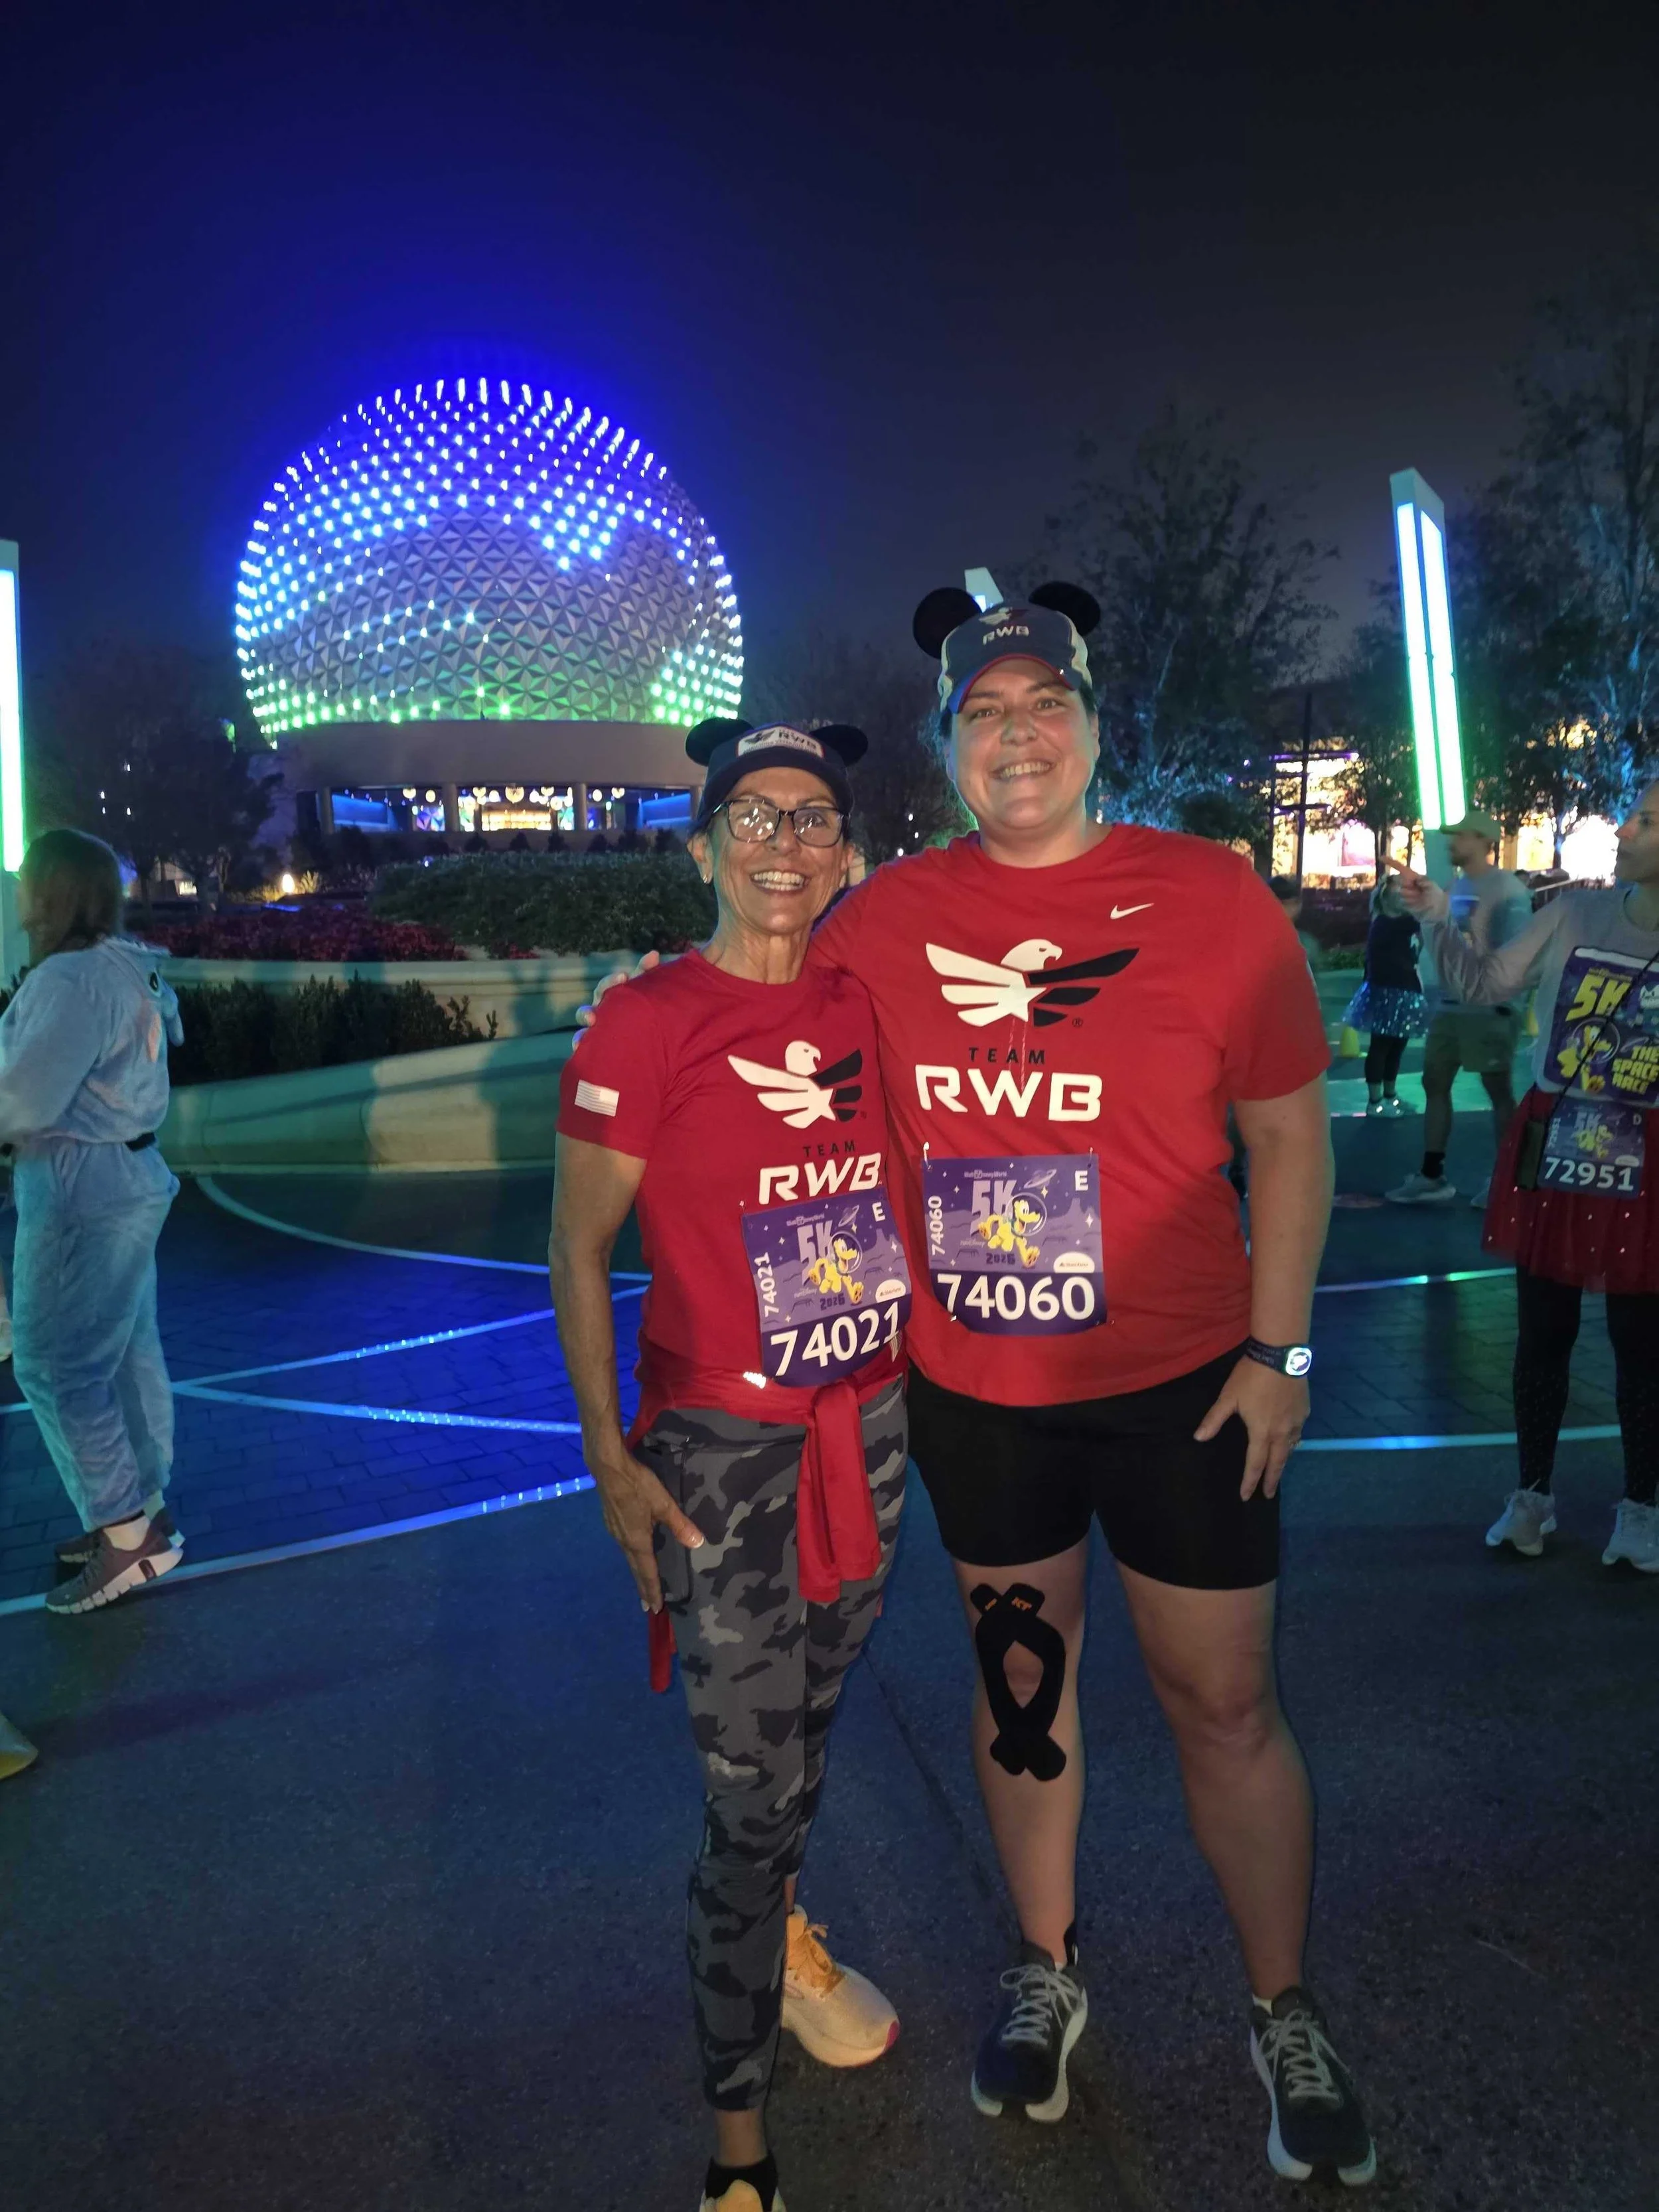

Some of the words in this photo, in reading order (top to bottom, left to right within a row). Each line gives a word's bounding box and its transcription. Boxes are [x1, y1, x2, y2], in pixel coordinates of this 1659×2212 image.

[982, 625, 1029, 645] RWB
[1565, 973, 1632, 1021] 5K
[968, 1047, 1046, 1065] TEAM
[1612, 1059, 1659, 1082] SPACE
[915, 1064, 1102, 1122] RWB
[1632, 1114, 1642, 1126] D
[802, 1140, 855, 1158] TEAM
[758, 1152, 881, 1205] RWB
[1074, 1170, 1089, 1191] E
[1544, 1156, 1634, 1191] 72951
[872, 1202, 886, 1222] E
[928, 1195, 946, 1256] 74060
[970, 1179, 1017, 1236] 5K
[797, 1220, 833, 1286] 5K
[754, 1252, 780, 1317] 74021
[820, 1293, 845, 1311] 2026
[937, 1273, 1095, 1321] 74060
[770, 1301, 899, 1376] 74021
